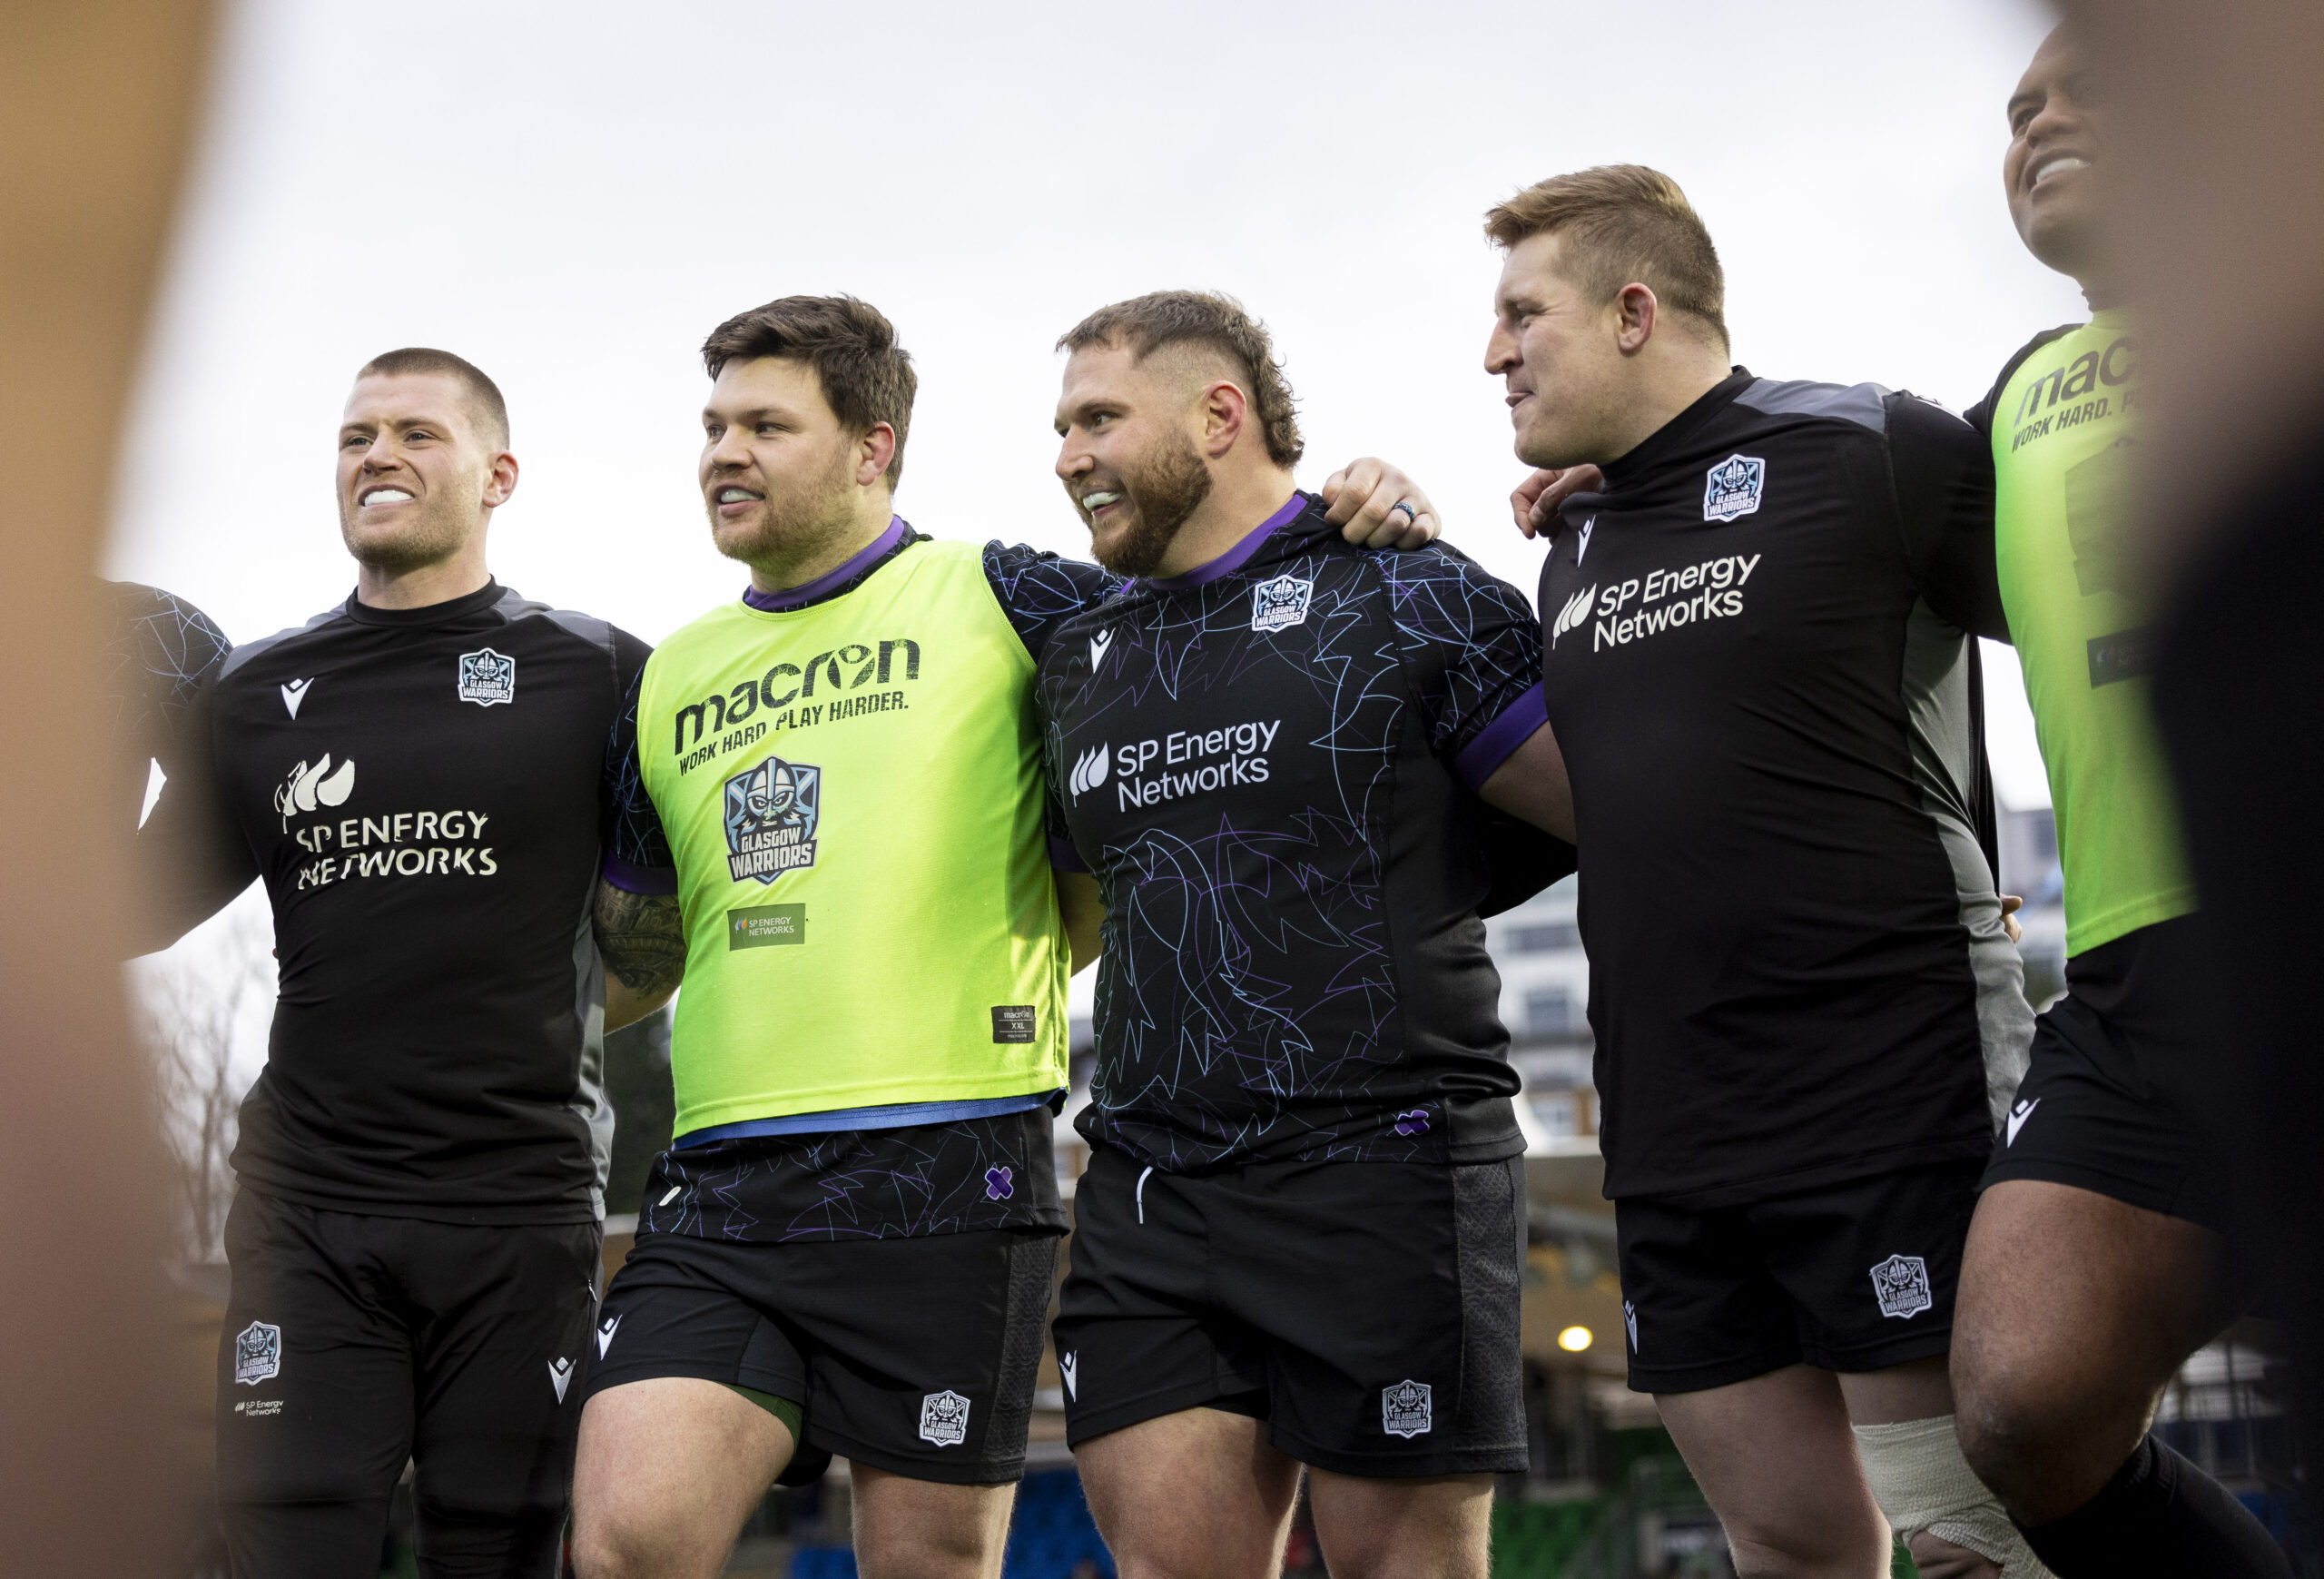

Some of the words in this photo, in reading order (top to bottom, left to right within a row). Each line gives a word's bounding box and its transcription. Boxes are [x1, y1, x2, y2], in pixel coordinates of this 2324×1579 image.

[2012, 415, 2054, 454] WORK
[2055, 398, 2112, 431] HARD.
[1716, 491, 1749, 504] GLASGOW
[1709, 498, 1755, 516] WARRIORS
[1597, 579, 1639, 617] SP
[1643, 554, 1761, 603] Energy
[1264, 606, 1296, 616] GLASGOW
[1256, 612, 1301, 627] WARRIORS
[1594, 587, 1744, 653] Networks
[469, 680, 503, 689] GLASGOW
[463, 687, 508, 699] WARRIORS
[675, 638, 921, 756] macron
[680, 741, 718, 776] WORK
[775, 705, 824, 731] PLAY
[829, 690, 910, 722] HARDER.
[1117, 740, 1158, 776] SP
[1167, 719, 1281, 765] Energy
[1118, 753, 1270, 814] Networks
[296, 824, 332, 854] SP
[741, 827, 801, 854] GLASGOW
[298, 846, 497, 890] NETWORKS
[731, 844, 812, 879] WARRIORS
[748, 919, 758, 928] SP
[759, 916, 792, 926] ENERGY
[749, 925, 794, 936] NETWORKS
[1888, 1288, 1918, 1301] GLASGOW
[1885, 1294, 1926, 1313] WARRIORS
[242, 1356, 270, 1367] GLASGOW
[238, 1363, 274, 1378] WARRIORS
[245, 1401, 256, 1410] SP
[256, 1400, 283, 1409] Energy
[246, 1407, 281, 1417] Networks
[1393, 1412, 1423, 1420] GLASGOW
[931, 1420, 958, 1430] GLASGOW
[1388, 1418, 1427, 1430] WARRIORS
[924, 1426, 961, 1440] WARRIORS
